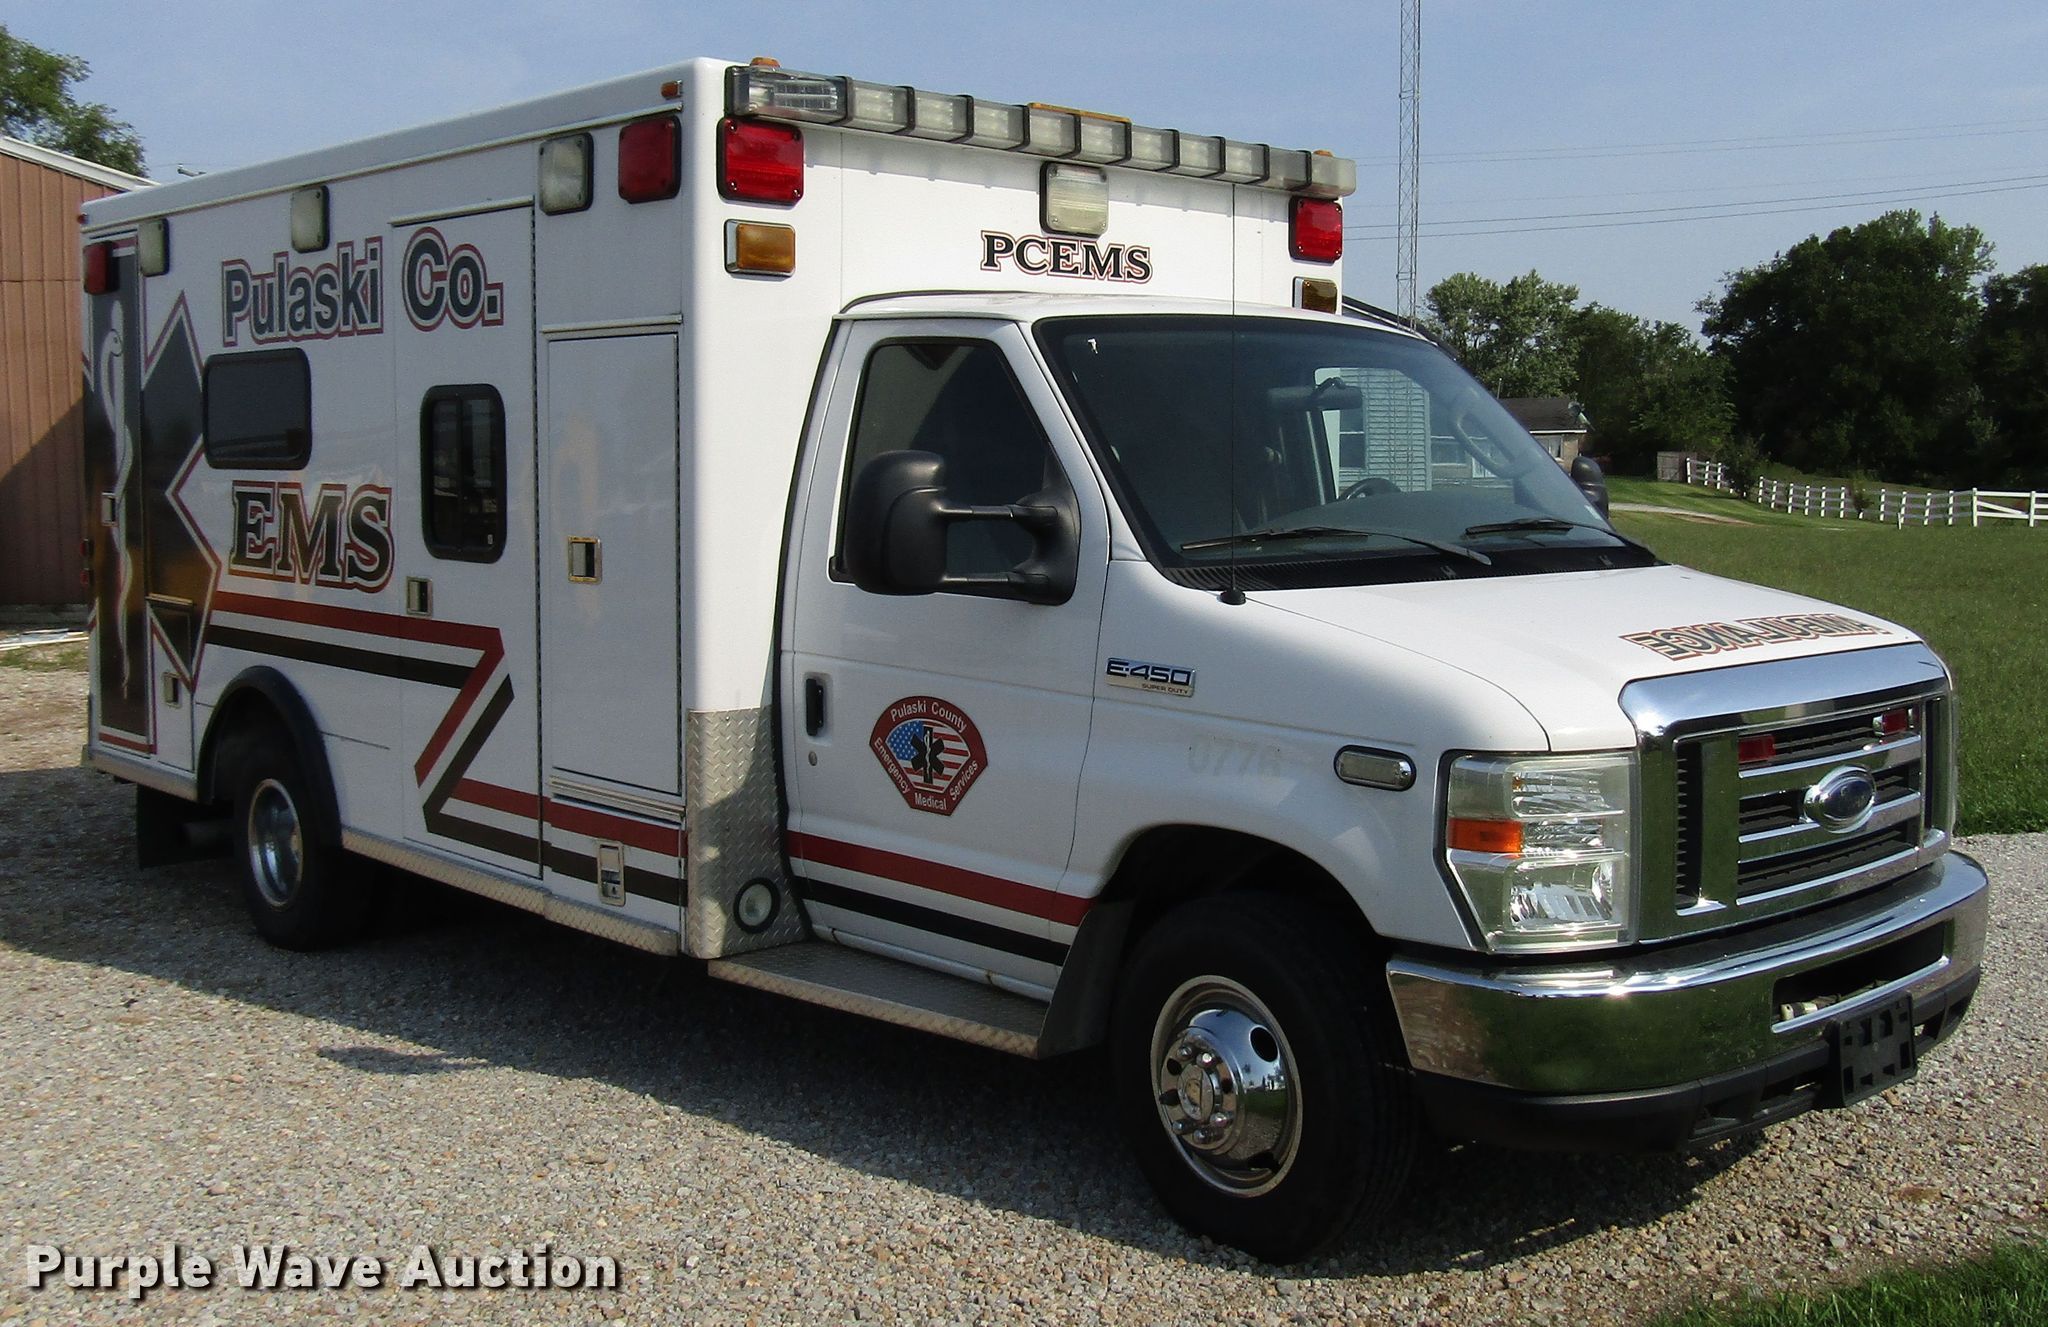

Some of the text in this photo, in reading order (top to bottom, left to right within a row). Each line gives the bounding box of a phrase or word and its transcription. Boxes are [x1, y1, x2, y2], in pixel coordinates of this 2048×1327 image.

[980, 230, 1153, 284] PCEMS
[221, 226, 504, 347] Pulaski Co.
[228, 480, 395, 593] EMS
[1106, 660, 1192, 686] E-450
[1142, 683, 1189, 695] SUPER DUTY
[890, 700, 968, 733] Pulaski County
[874, 737, 978, 810] Emergency Medical Services
